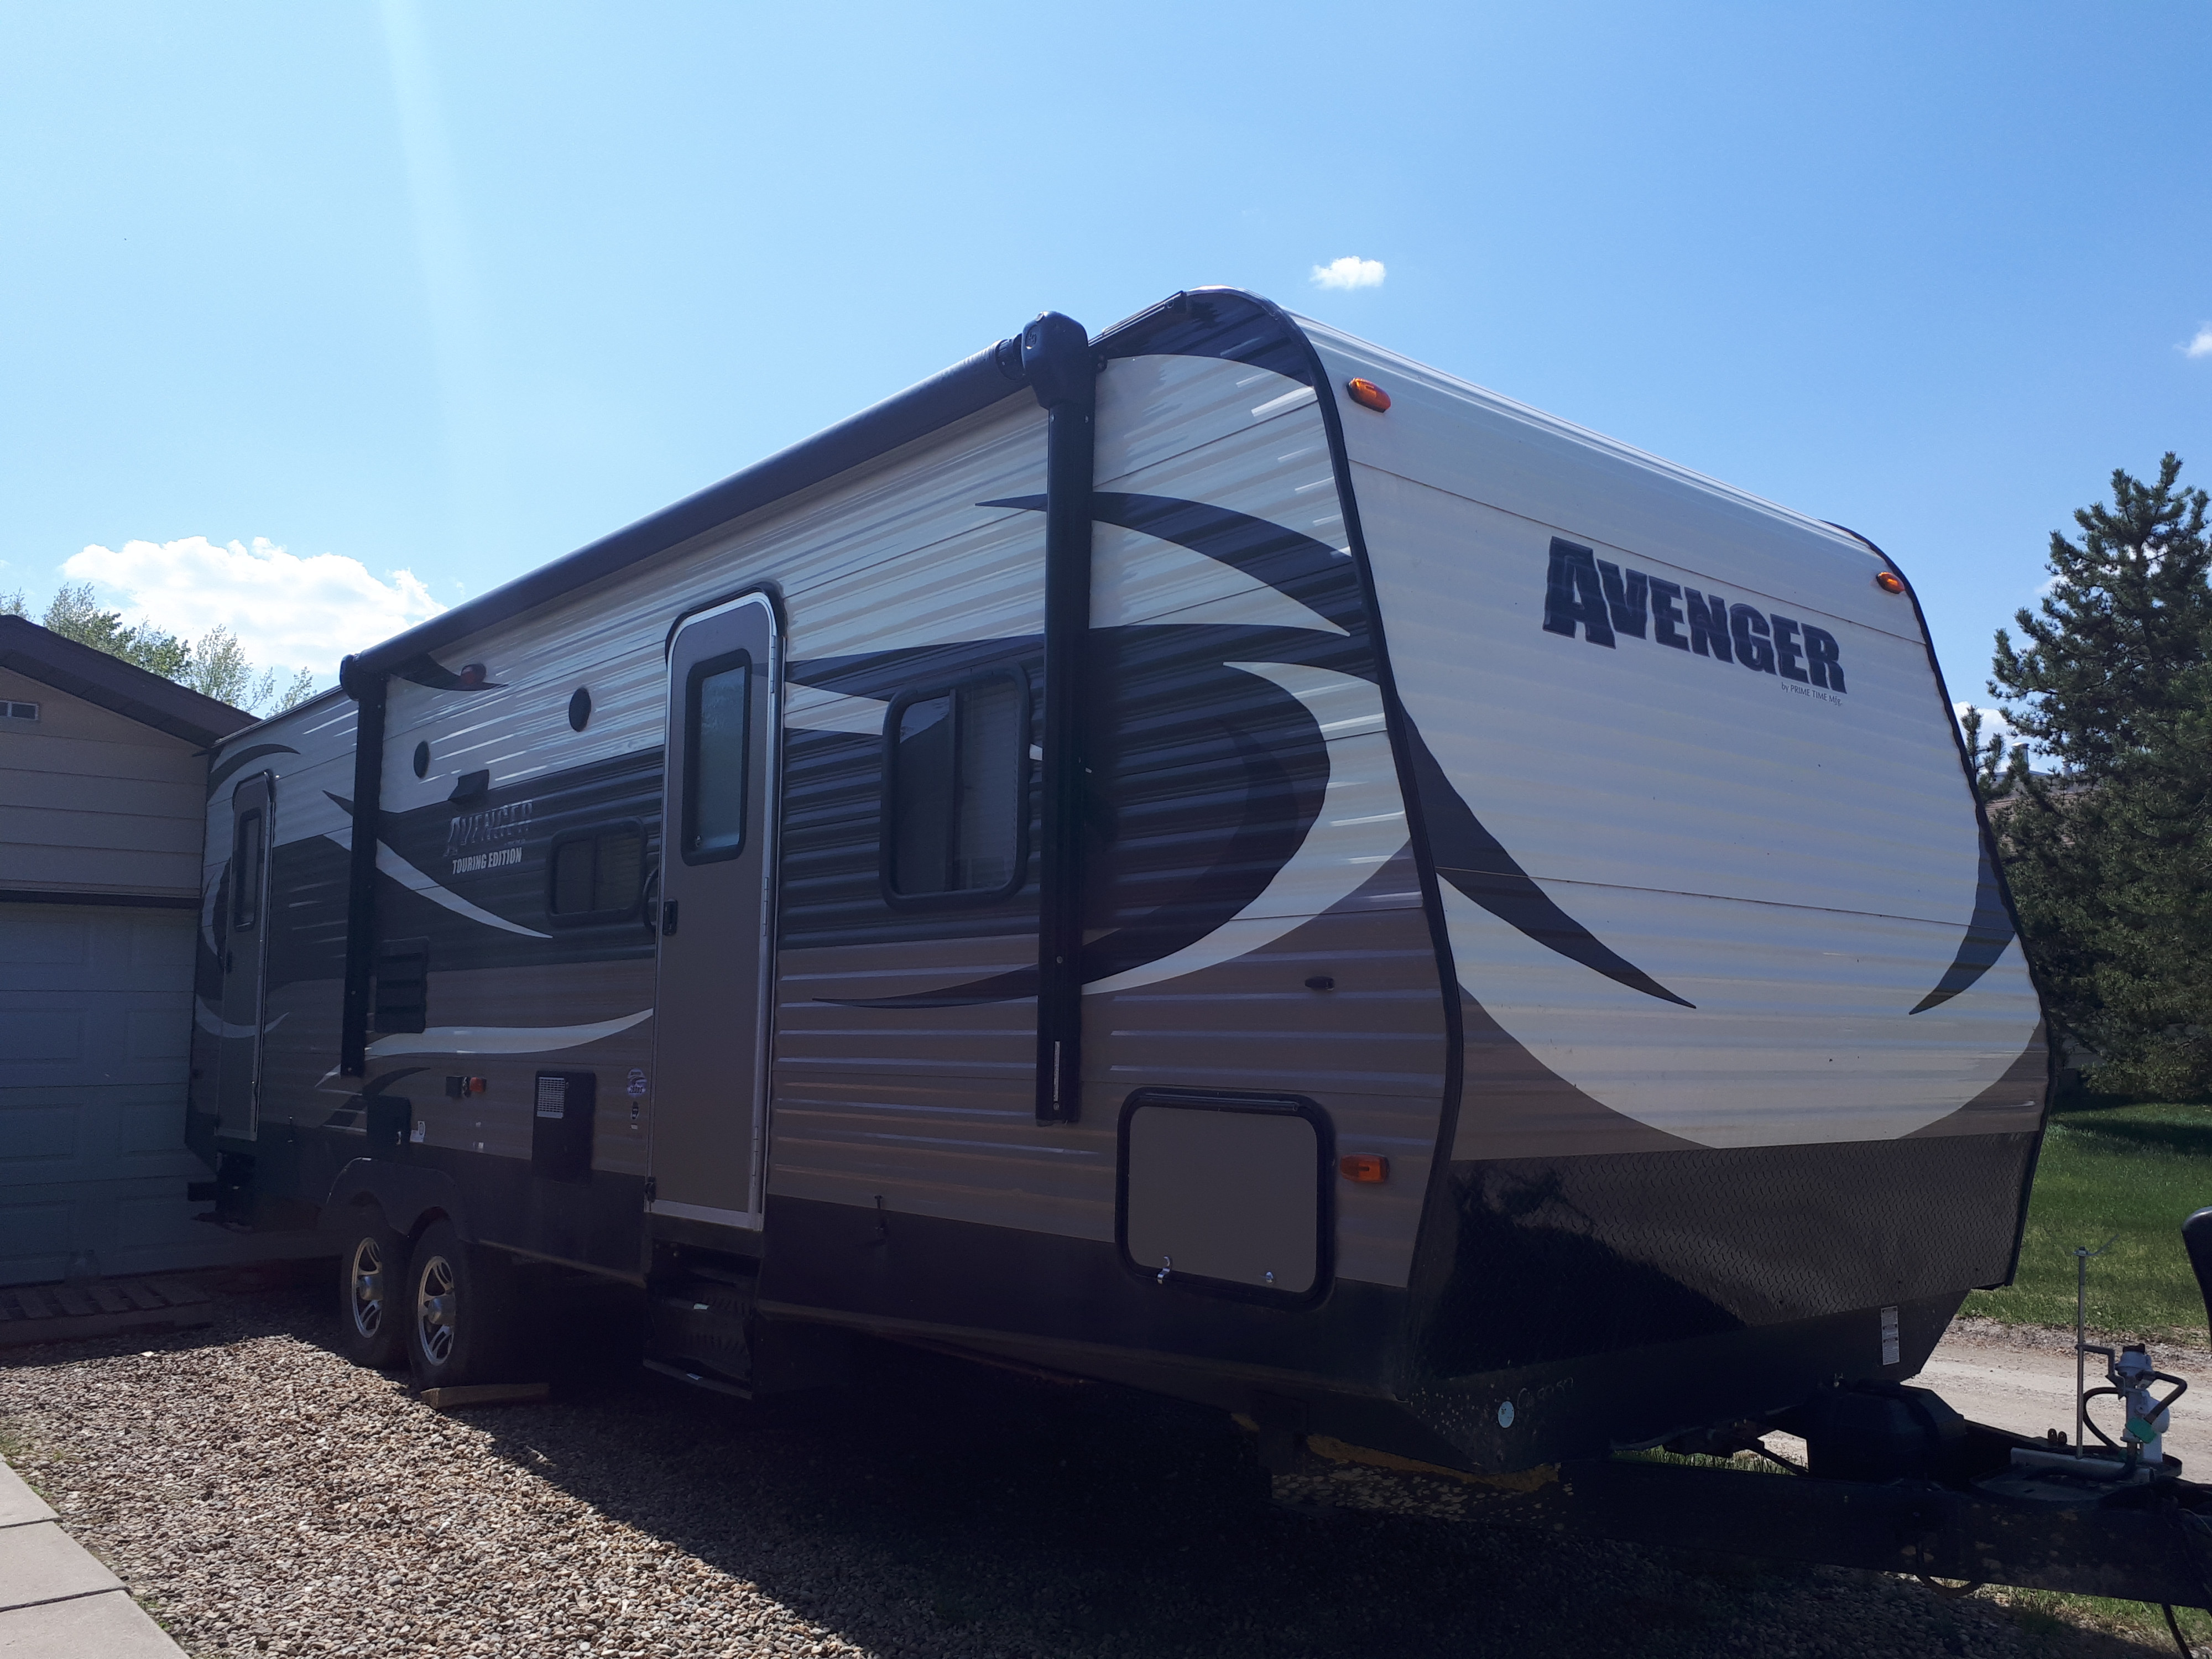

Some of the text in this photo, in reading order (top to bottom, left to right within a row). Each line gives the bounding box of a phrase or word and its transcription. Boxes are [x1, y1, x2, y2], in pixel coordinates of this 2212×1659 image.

[1543, 536, 1847, 694] AVENGER
[1781, 681, 1789, 693] by
[1791, 685, 1810, 697] PRIME
[1812, 690, 1827, 701] TIME
[452, 847, 522, 875] TOURING EDITION
